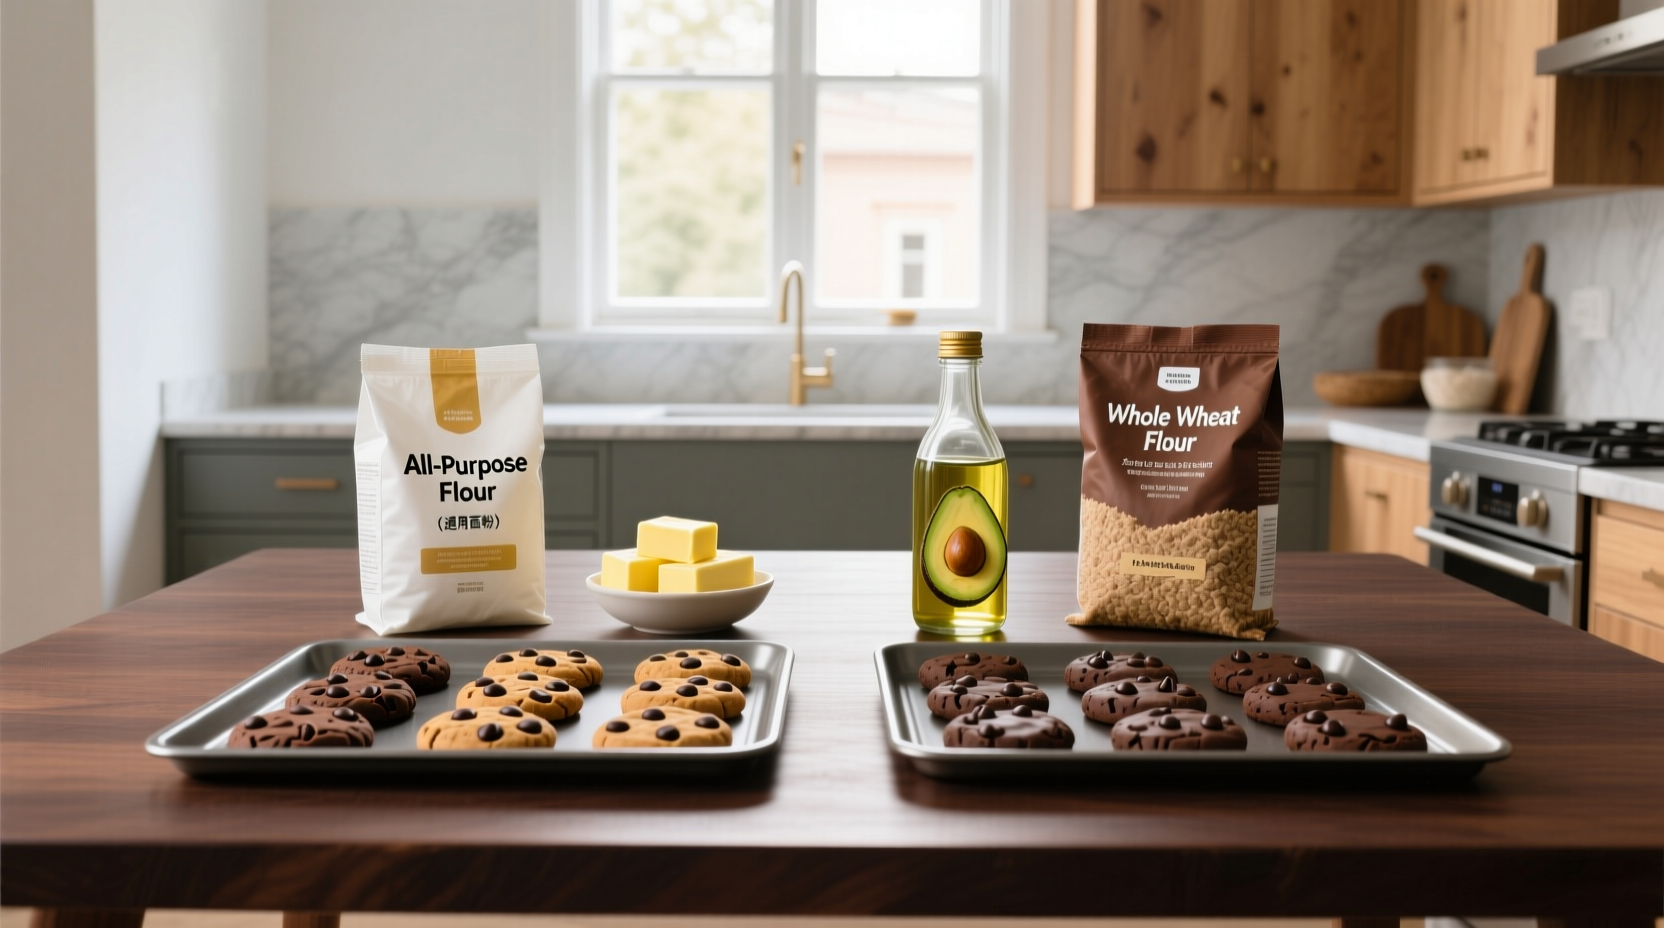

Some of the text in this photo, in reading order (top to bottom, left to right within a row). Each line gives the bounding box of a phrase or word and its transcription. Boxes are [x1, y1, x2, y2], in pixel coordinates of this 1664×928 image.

[1108, 402, 1241, 427] Whole Wheat
[1143, 430, 1198, 452] Flour
[403, 453, 528, 481] All-Purpose
[439, 480, 497, 502] Flour
